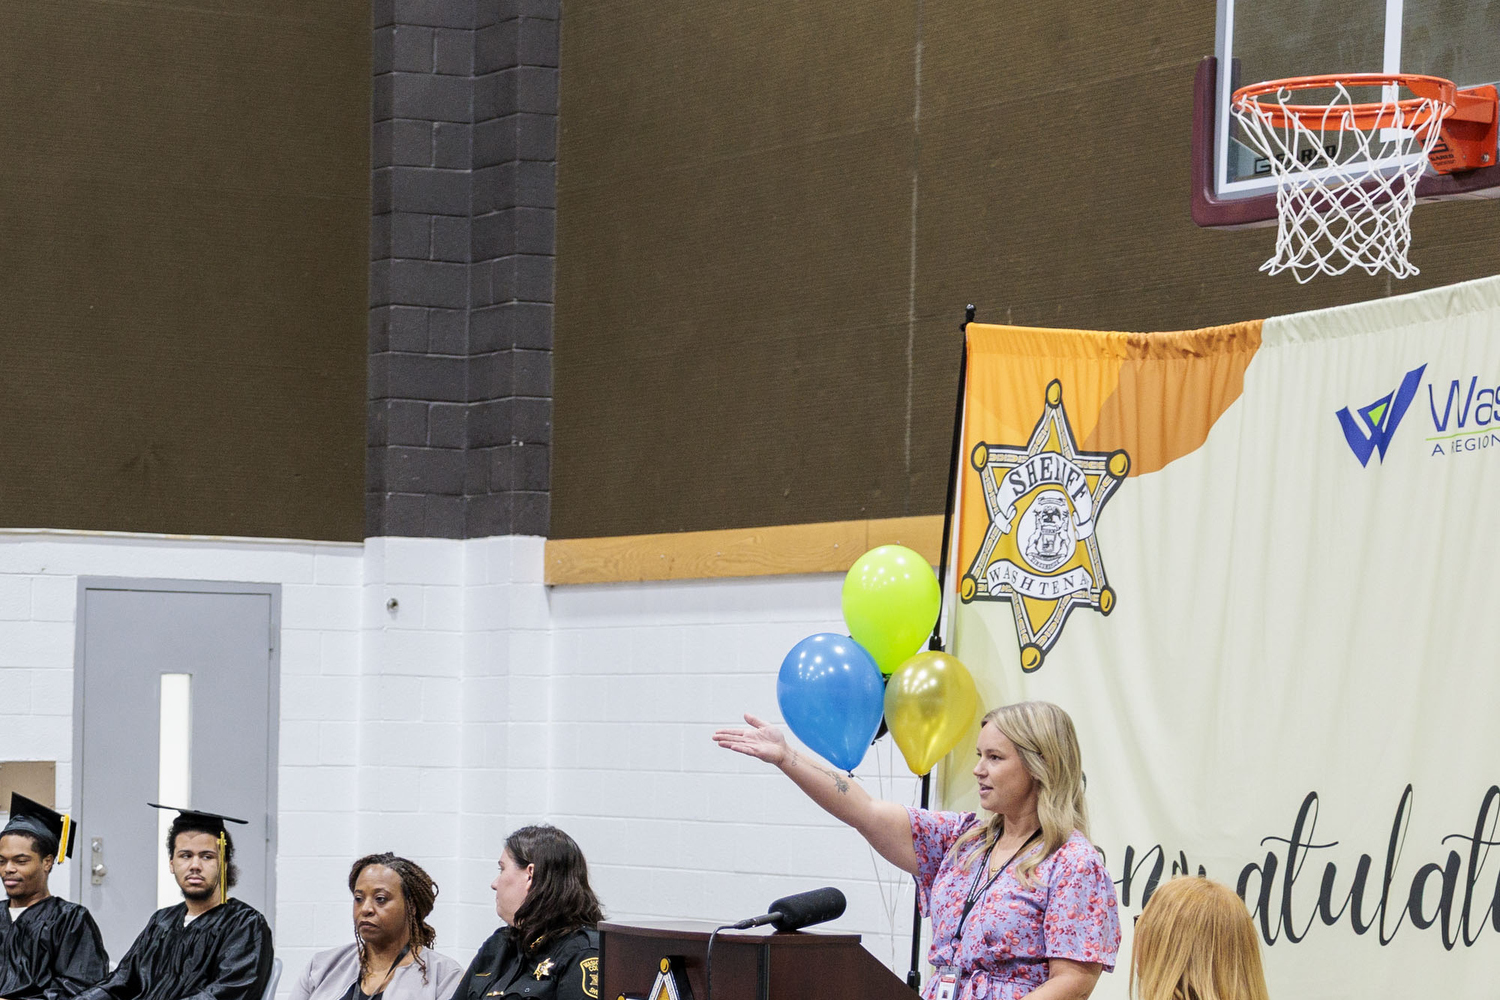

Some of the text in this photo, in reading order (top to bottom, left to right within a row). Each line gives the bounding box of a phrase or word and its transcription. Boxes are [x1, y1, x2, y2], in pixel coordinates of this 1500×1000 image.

[1431, 443, 1445, 457] A
[1008, 456, 1090, 502] SHEIFF
[989, 565, 1089, 595] WASHTENA
